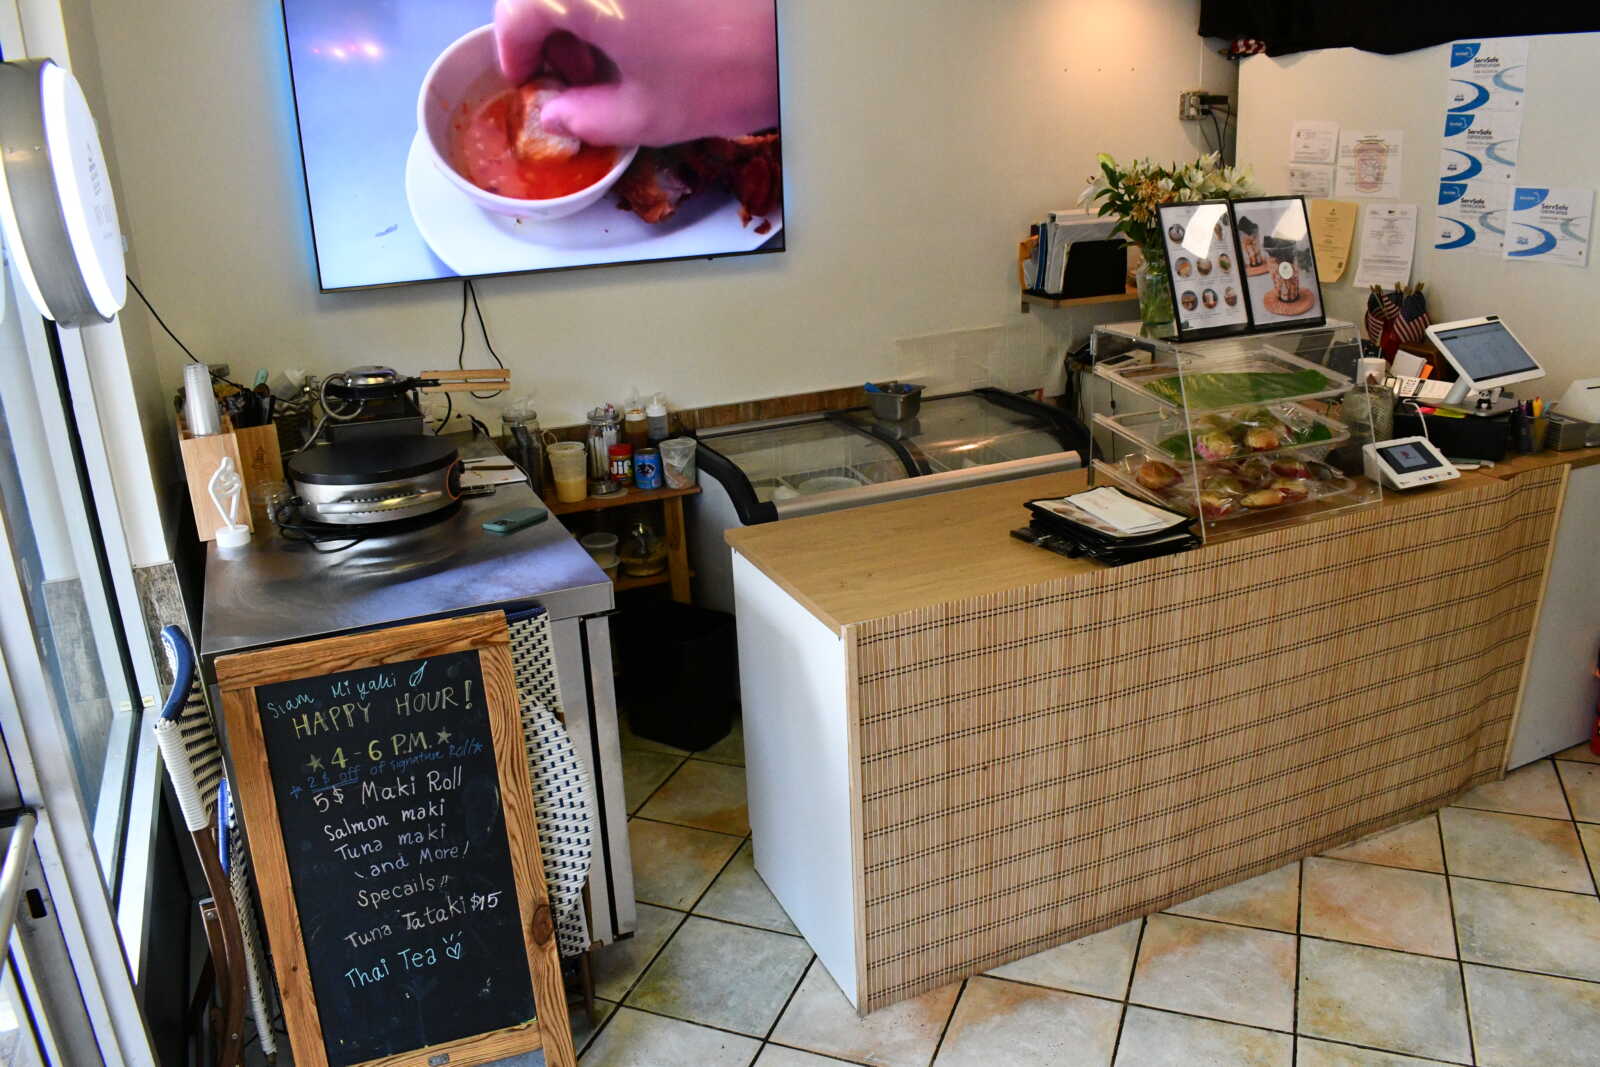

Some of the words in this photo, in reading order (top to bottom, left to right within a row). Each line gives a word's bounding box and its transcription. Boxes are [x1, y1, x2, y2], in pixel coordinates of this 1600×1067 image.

[610, 459, 632, 475] Jif
[267, 693, 315, 719] Siam
[292, 701, 371, 740] HAPPY
[362, 776, 416, 805] Maki
[427, 765, 462, 793] Roll
[324, 818, 389, 841] Salmon
[401, 798, 446, 822] maki
[334, 839, 383, 861] Tuna
[398, 823, 446, 846] maki
[370, 855, 409, 877] and
[344, 924, 393, 948] Tuna
[401, 895, 467, 930] Tataki
[470, 890, 503, 912] $15
[345, 958, 390, 988] Thai
[397, 948, 437, 970] Tea
